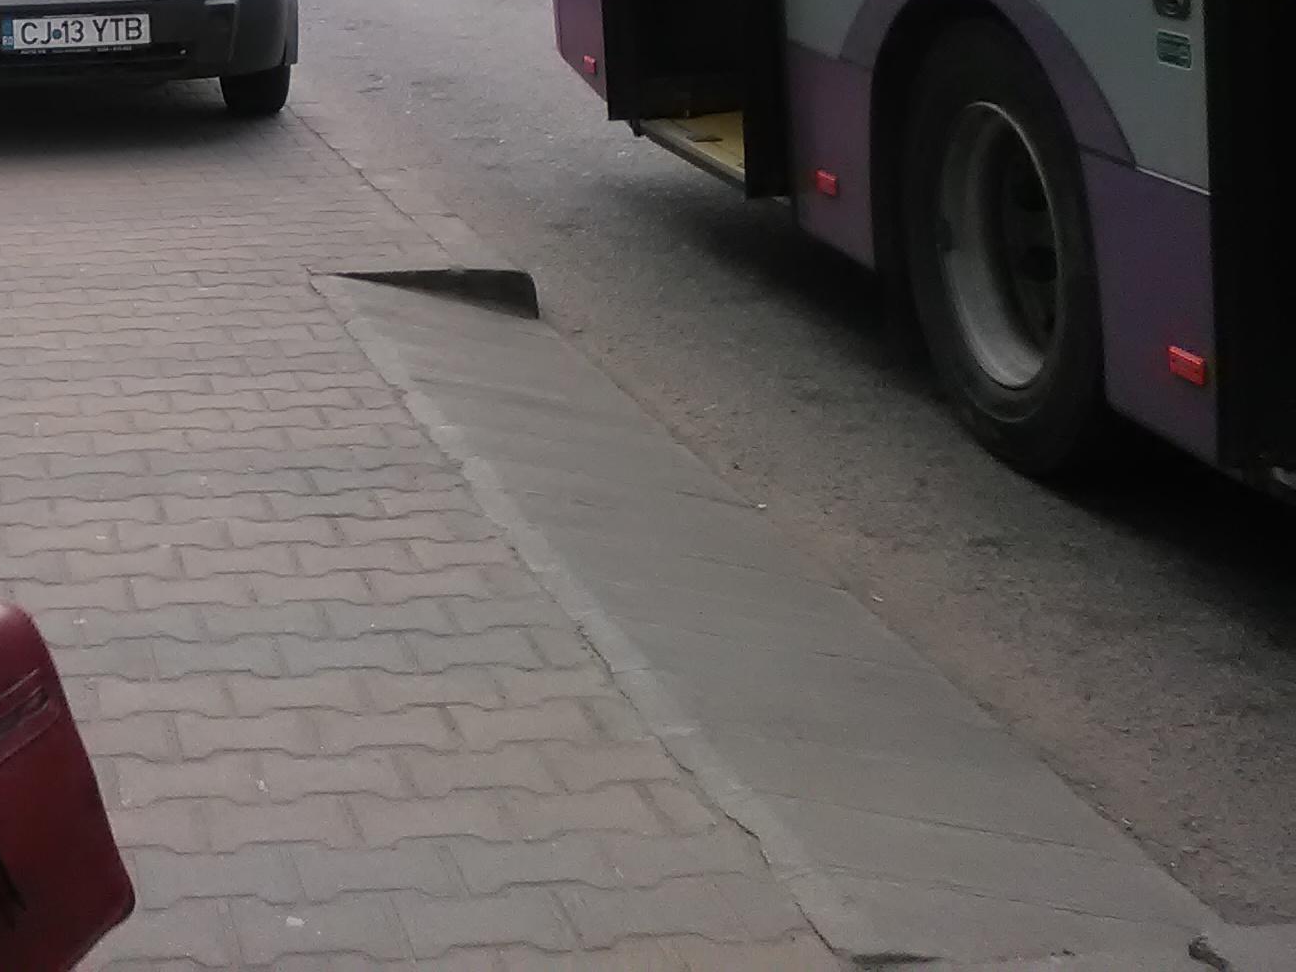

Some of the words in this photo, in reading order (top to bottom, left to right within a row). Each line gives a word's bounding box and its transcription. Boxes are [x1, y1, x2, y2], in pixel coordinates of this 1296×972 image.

[21, 21, 52, 45] CJ
[61, 20, 85, 43] 13
[93, 17, 143, 42] YTB
